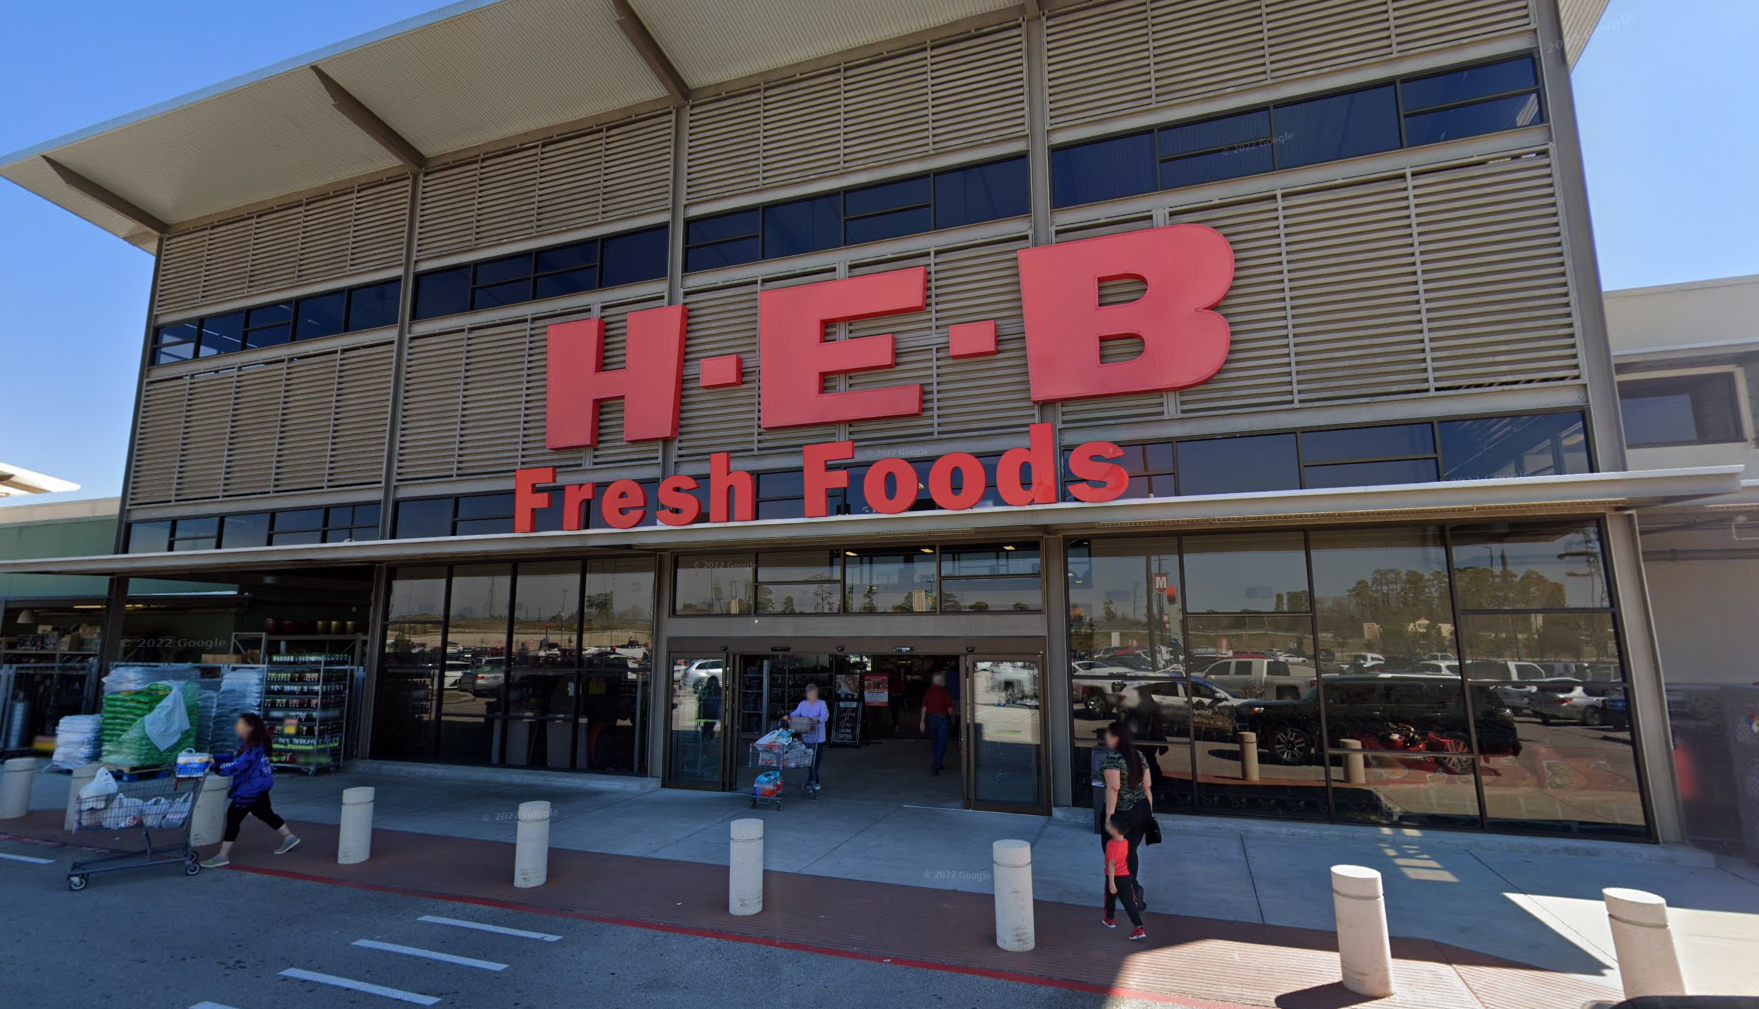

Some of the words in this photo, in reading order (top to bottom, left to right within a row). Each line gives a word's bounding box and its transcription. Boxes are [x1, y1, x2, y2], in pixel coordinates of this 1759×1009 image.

[545, 222, 1237, 450] H-E-B
[513, 451, 757, 533] Fresh
[803, 421, 1131, 519] Foods
[838, 708, 856, 720] Coffee
